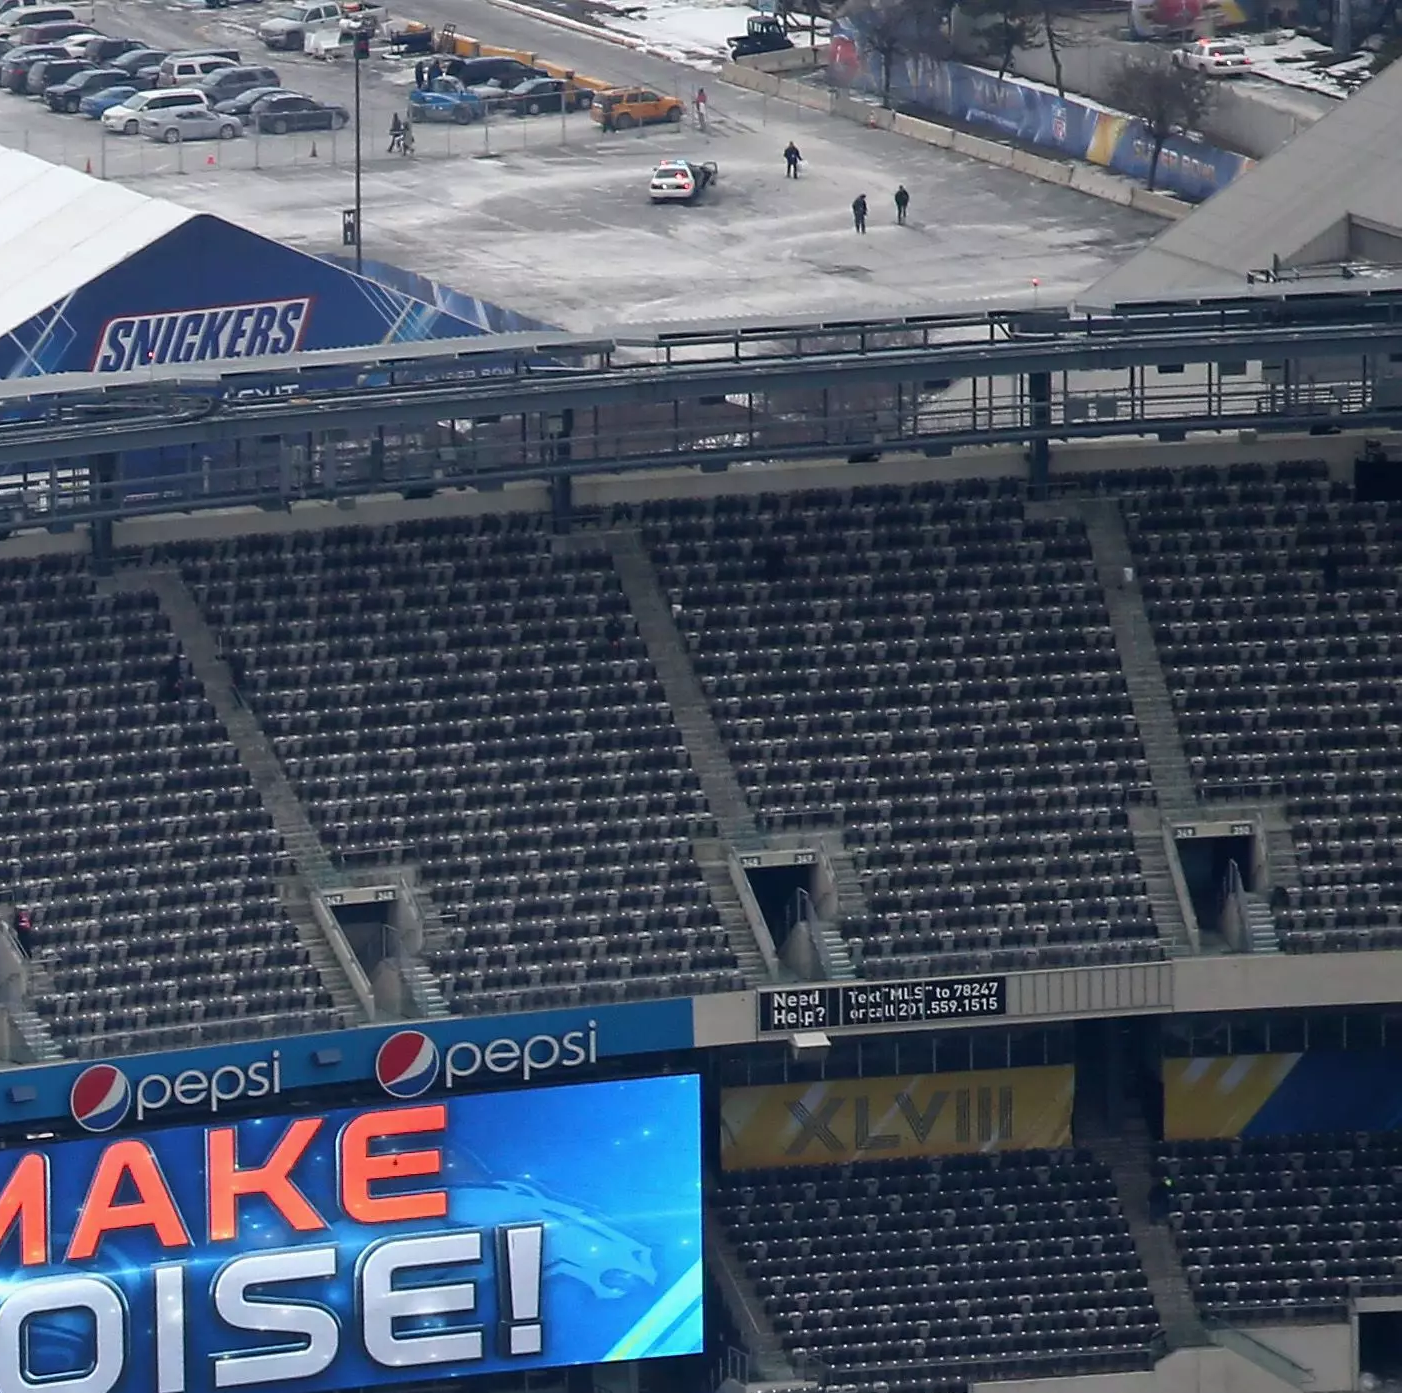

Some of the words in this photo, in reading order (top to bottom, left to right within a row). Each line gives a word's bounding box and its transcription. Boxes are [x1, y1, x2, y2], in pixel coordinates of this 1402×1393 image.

[345, 213, 353, 224] M
[99, 302, 305, 371] SNICKERS
[774, 991, 819, 1008] Need
[849, 991, 881, 1004] Text
[936, 987, 950, 999] to
[954, 982, 998, 997] 78247
[774, 1007, 826, 1026] Help?
[850, 1009, 864, 1019] or
[869, 1003, 895, 1018] call
[898, 997, 998, 1016] 201.559.1515
[445, 1020, 599, 1092] pepsi
[137, 1050, 282, 1120] pepsi
[784, 1086, 1013, 1156] XLVIII
